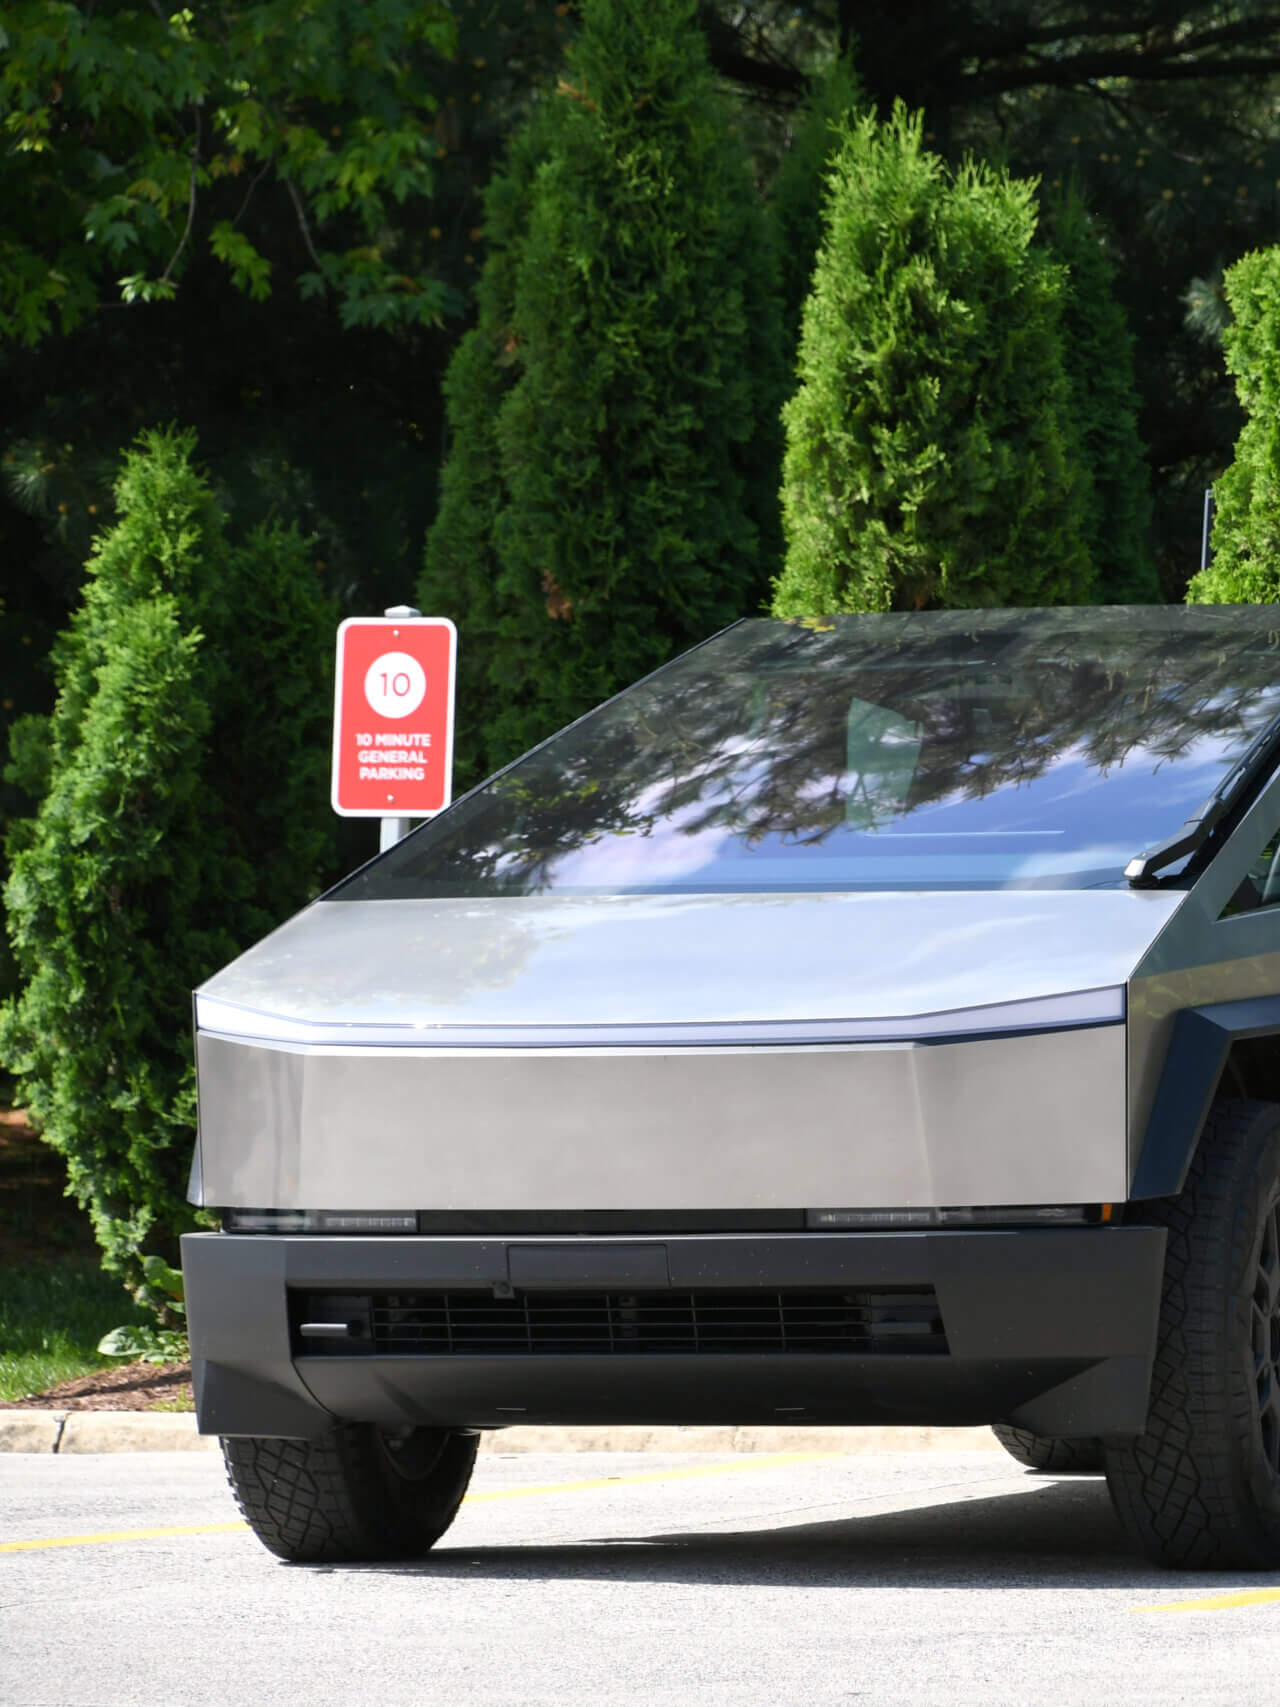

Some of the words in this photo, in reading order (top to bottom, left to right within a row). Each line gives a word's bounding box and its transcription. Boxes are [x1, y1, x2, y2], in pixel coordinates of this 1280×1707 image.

[379, 671, 411, 697] 10
[355, 732, 373, 747] 10
[375, 732, 432, 747] MINUTE
[357, 749, 429, 764] GENERAL
[359, 766, 426, 781] PARKING
